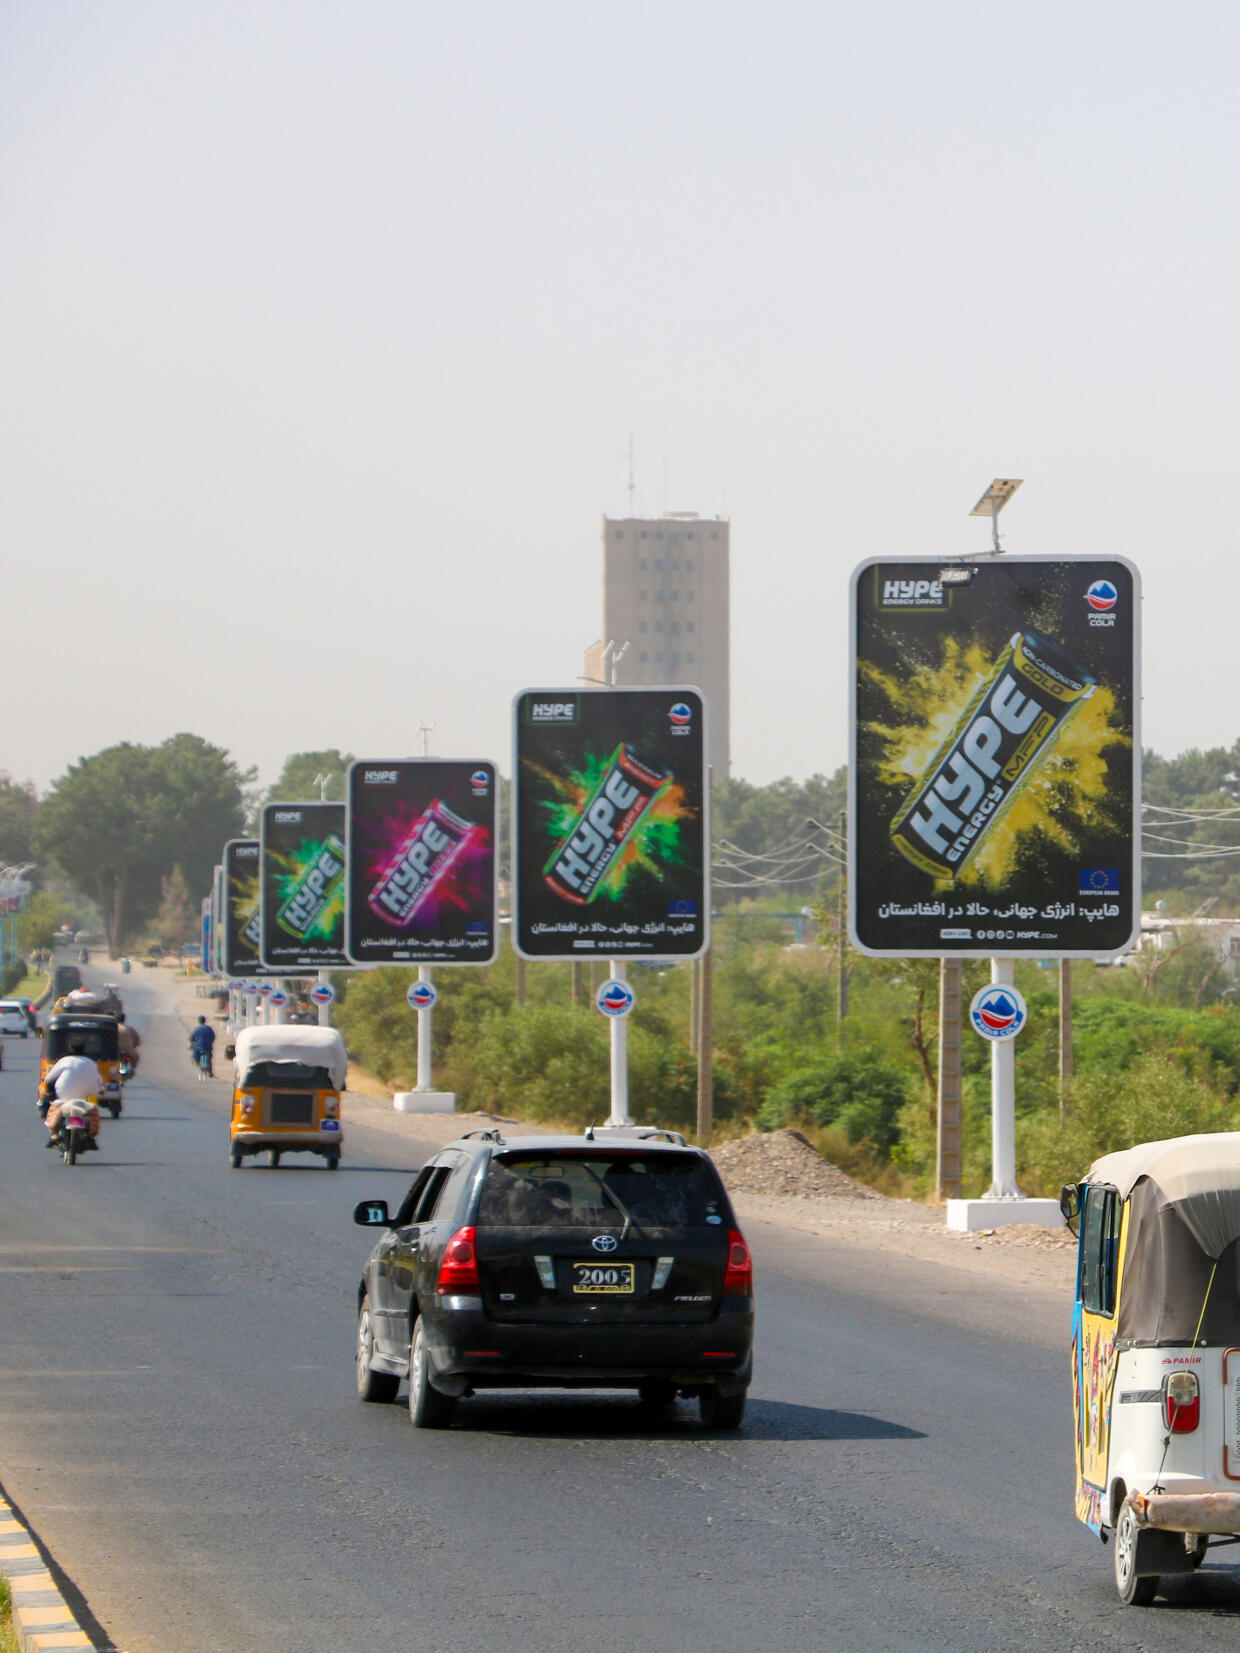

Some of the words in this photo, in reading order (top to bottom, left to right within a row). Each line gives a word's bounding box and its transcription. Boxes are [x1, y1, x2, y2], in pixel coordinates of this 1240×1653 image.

[884, 580, 943, 598] HYPE
[1023, 663, 1064, 695] GOLD
[532, 704, 574, 716] HYPE
[365, 771, 396, 780] HYPE
[910, 673, 1043, 855] HYPE
[556, 769, 640, 889] HYPE
[946, 785, 1004, 862] ENERGY
[380, 821, 450, 913] HYPE
[580, 843, 616, 893] ENERGY
[285, 852, 341, 931] HYPE
[878, 902, 945, 918] افغانستان
[947, 905, 963, 918] در
[966, 903, 990, 917] حالا
[579, 1269, 630, 1284] 2005
